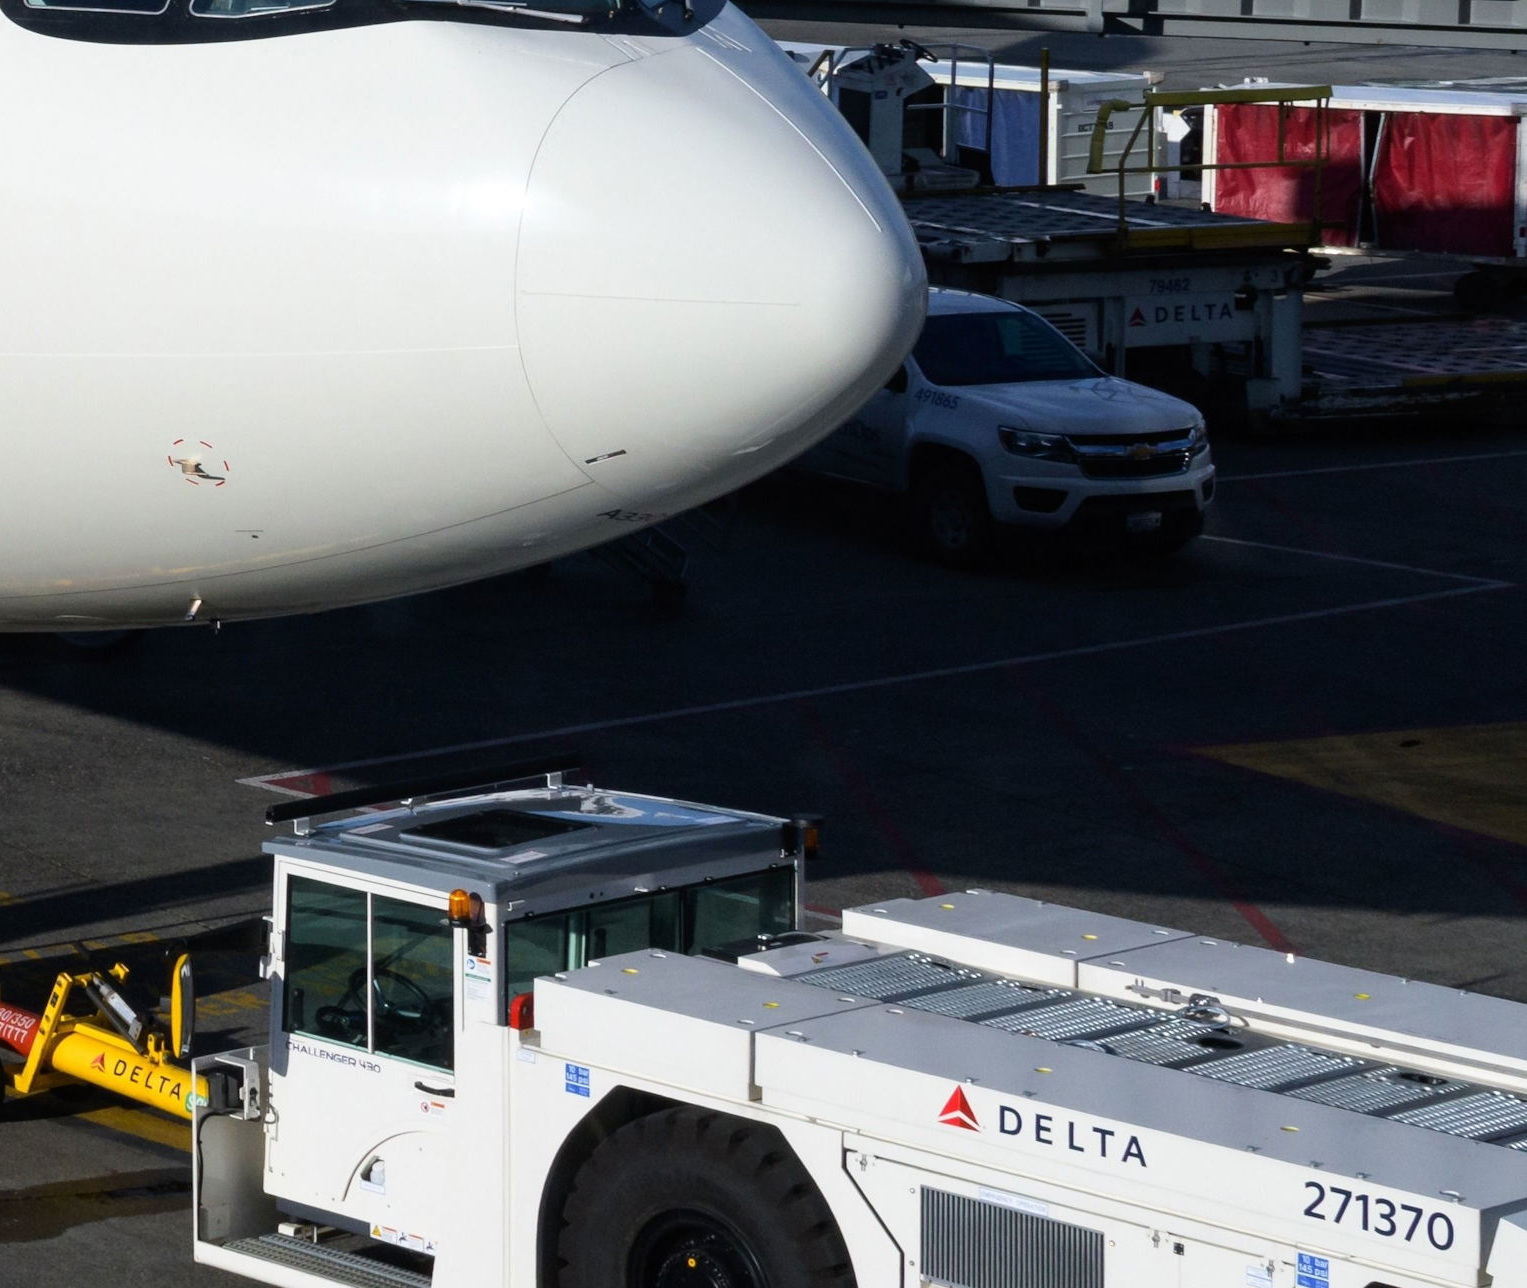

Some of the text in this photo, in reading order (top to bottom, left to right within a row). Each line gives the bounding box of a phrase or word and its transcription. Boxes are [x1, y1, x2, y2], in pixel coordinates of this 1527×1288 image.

[1155, 303, 1233, 323] DELTA
[286, 1041, 381, 1074] CHALLENGER 430
[113, 1059, 182, 1101] DELTA
[999, 1105, 1147, 1168] DELTA
[1303, 1181, 1455, 1251] 271370
